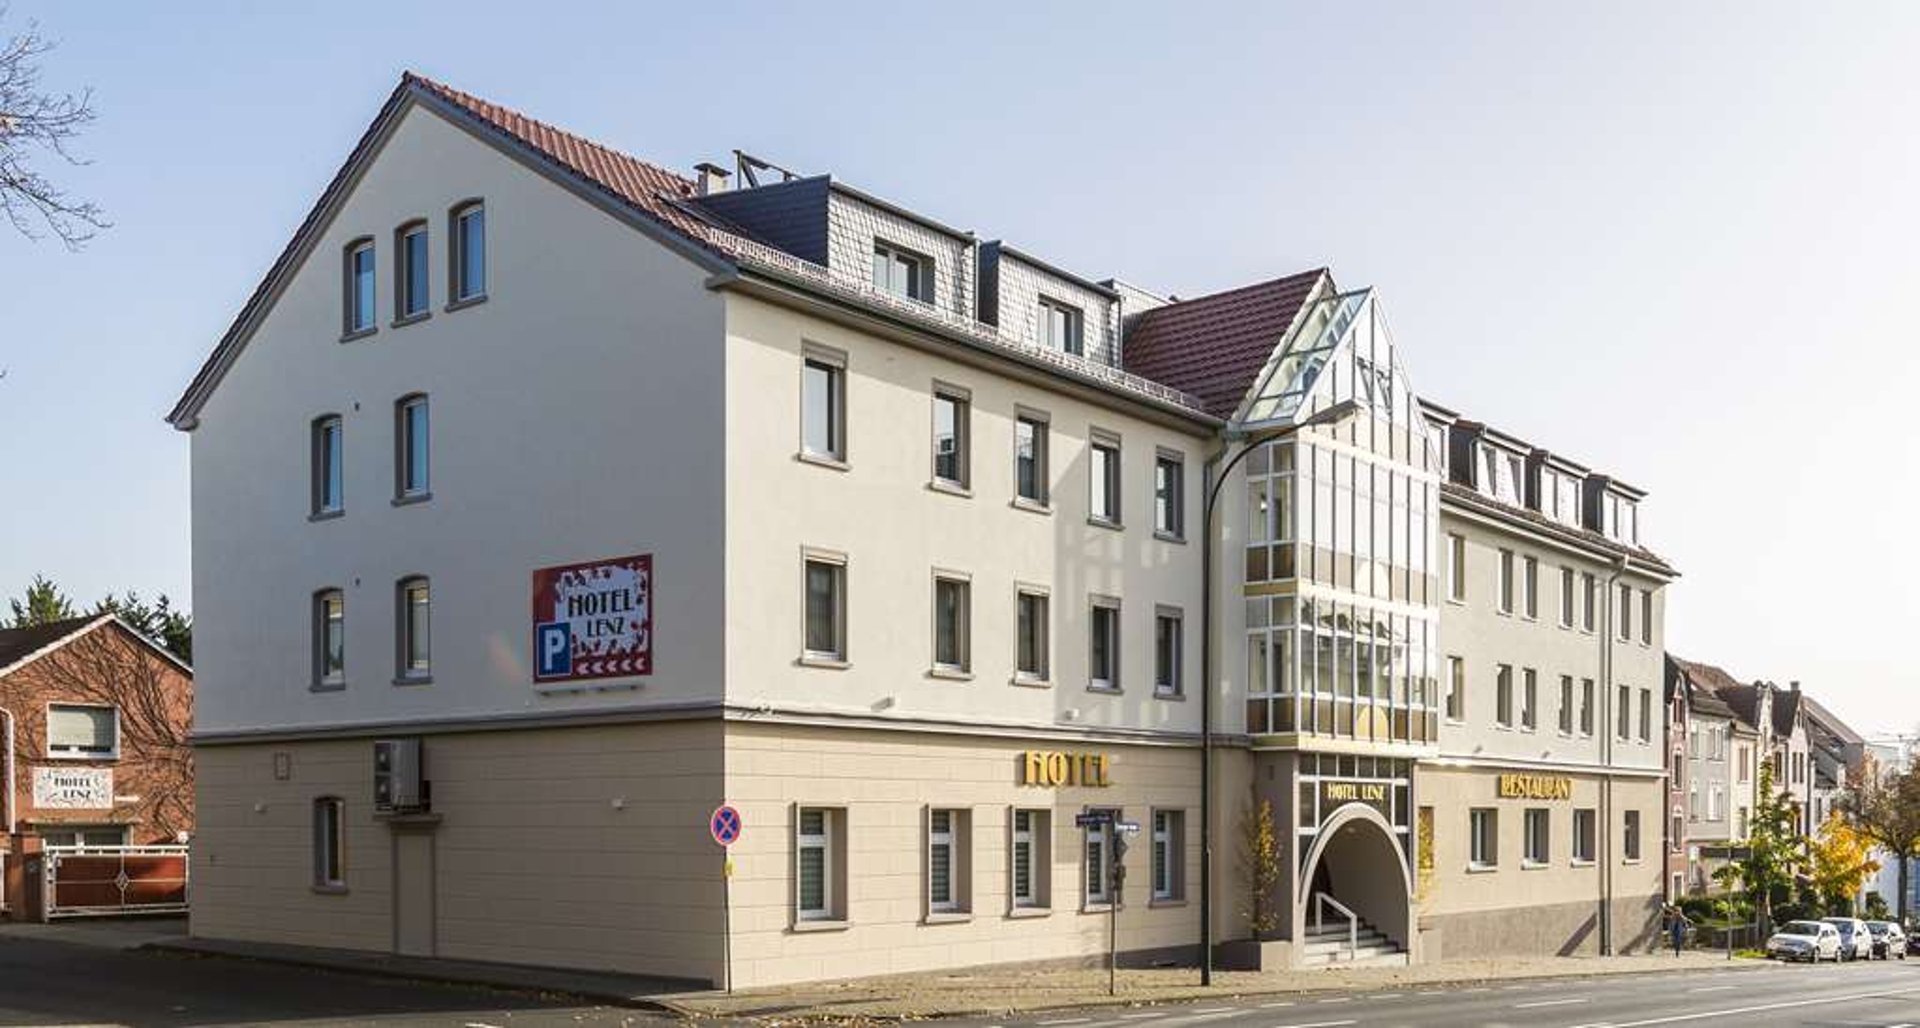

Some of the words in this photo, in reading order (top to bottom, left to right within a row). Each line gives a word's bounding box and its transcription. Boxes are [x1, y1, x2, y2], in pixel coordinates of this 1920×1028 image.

[568, 588, 634, 618] HOTEL
[586, 616, 625, 638] LENZ
[544, 628, 566, 671] P
[1023, 751, 1110, 787] HOTEL
[1328, 783, 1359, 800] HOTEL
